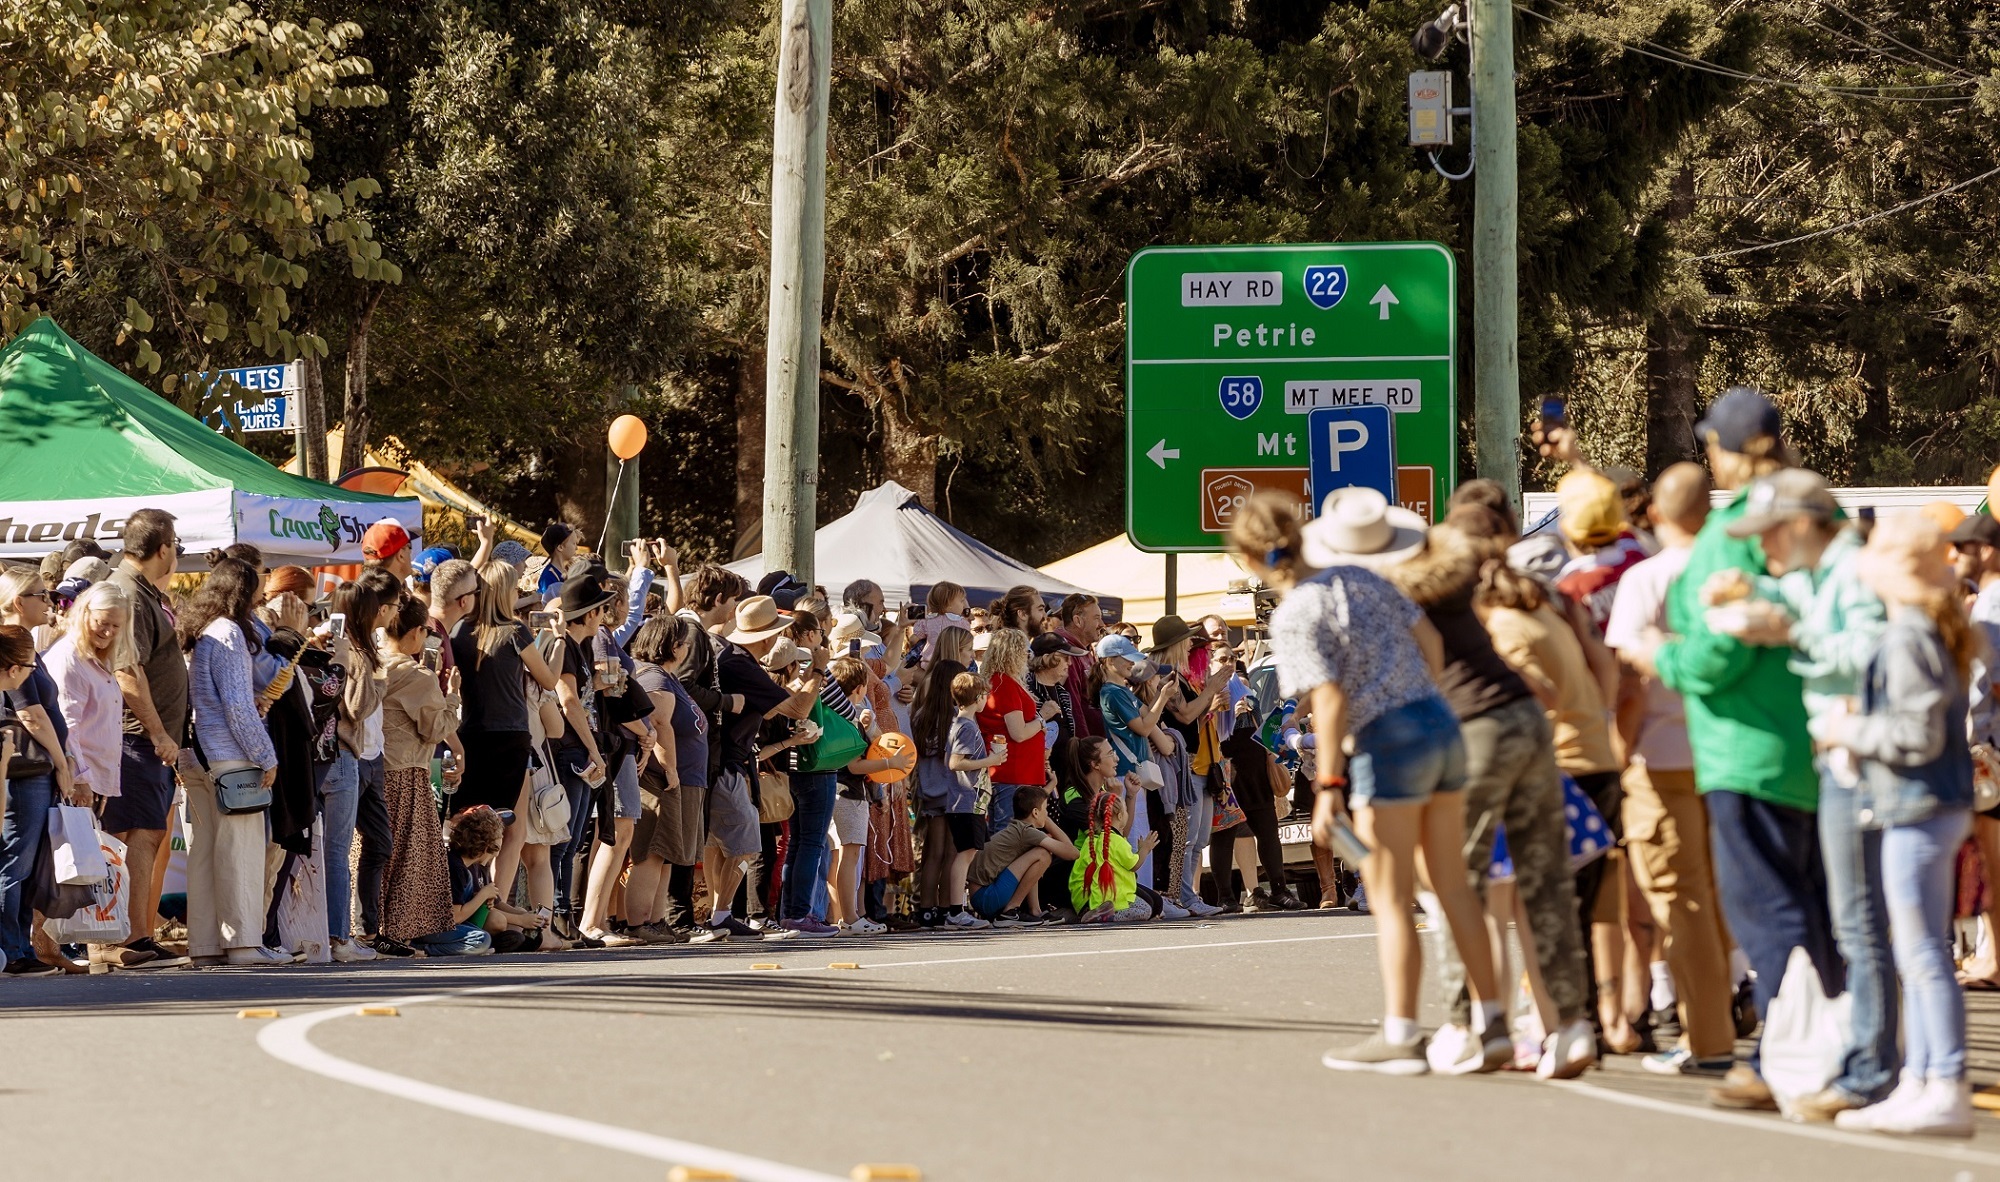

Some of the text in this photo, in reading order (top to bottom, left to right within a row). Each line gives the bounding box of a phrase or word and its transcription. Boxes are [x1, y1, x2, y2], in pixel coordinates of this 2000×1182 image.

[1190, 280, 1274, 299] HAY RD
[1311, 271, 1340, 296] 22
[1213, 322, 1316, 347] Petrie
[211, 368, 280, 390] LETS
[1227, 382, 1255, 407] 58
[1292, 387, 1414, 406] MT MEE RD
[240, 413, 281, 430] OURTS
[1257, 432, 1297, 456] Mt
[1329, 420, 1369, 472] P
[1214, 481, 1248, 491] TOURIST DRIVE
[1217, 495, 1246, 517] 29
[268, 508, 325, 542] Croc
